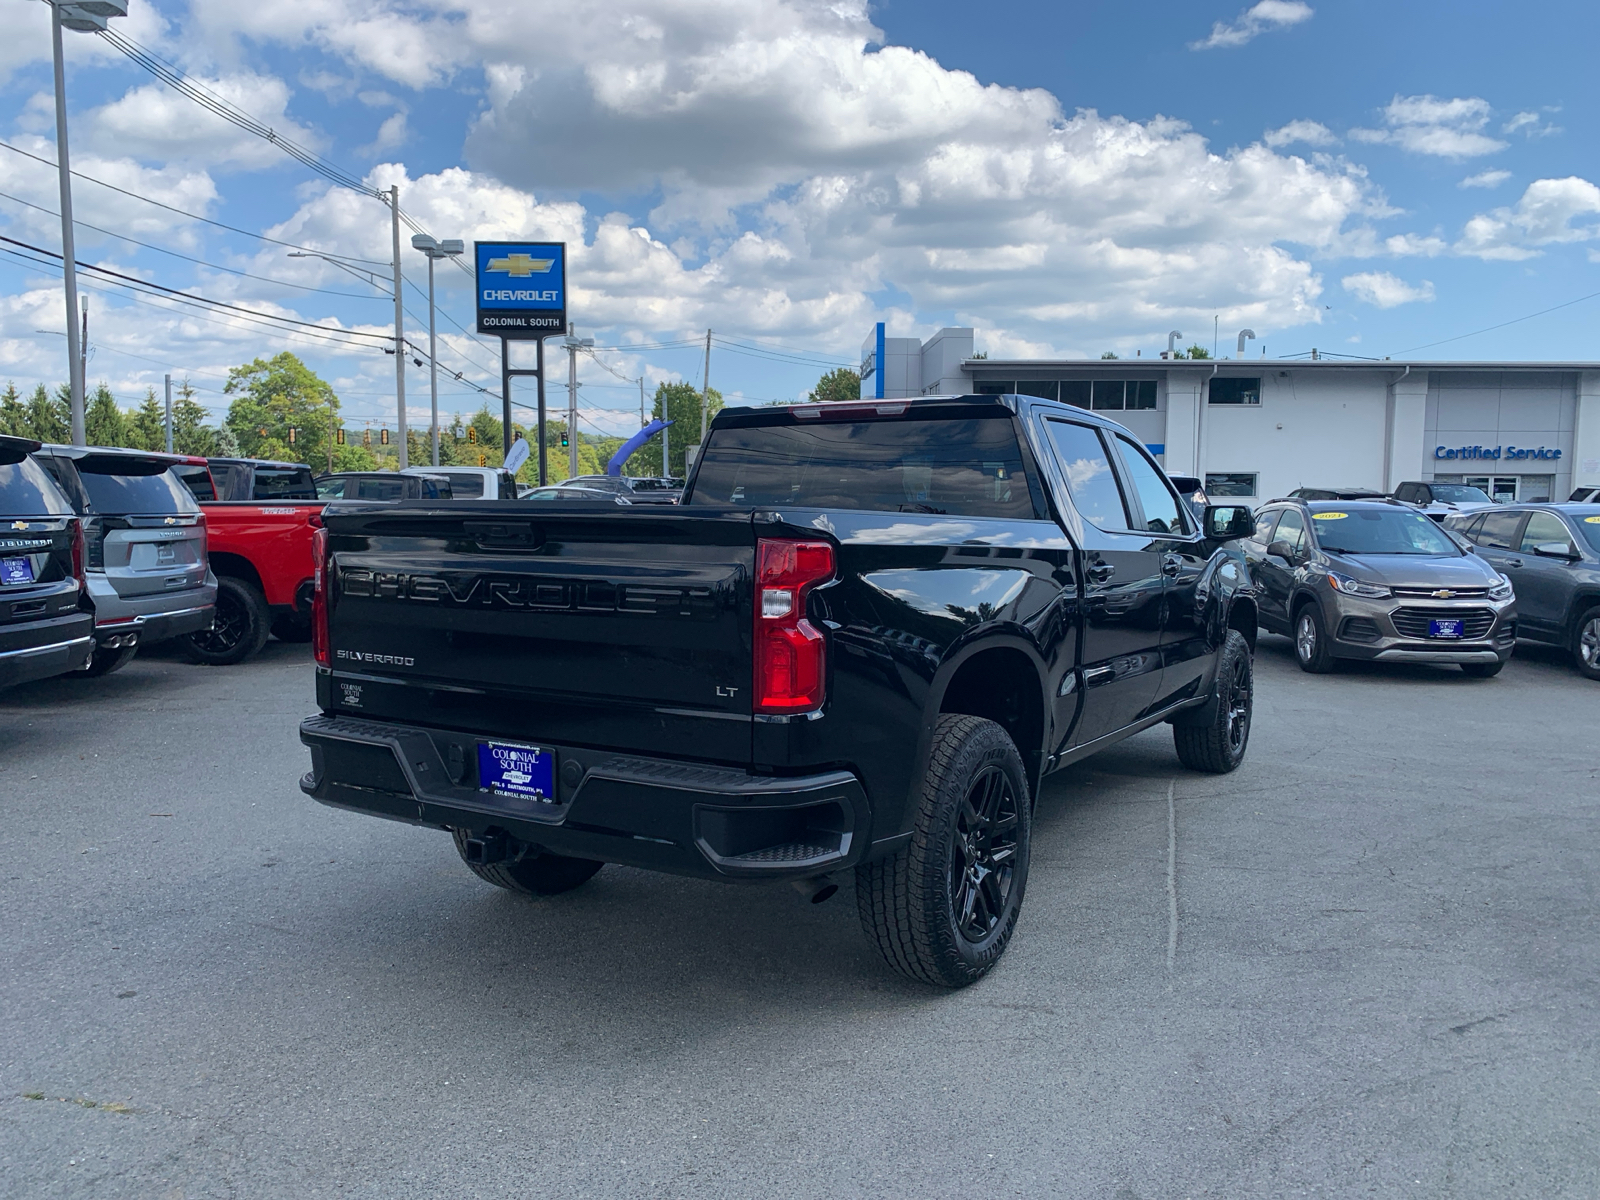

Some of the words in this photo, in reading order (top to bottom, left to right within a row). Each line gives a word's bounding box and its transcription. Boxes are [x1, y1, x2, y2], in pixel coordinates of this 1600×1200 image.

[483, 290, 559, 301] CHEVROLET
[483, 317, 528, 326] COLONIAL
[529, 318, 560, 327] SOUTH
[1435, 445, 1502, 460] Certified
[1506, 446, 1562, 460] Service
[0, 539, 53, 547] UBURBAN
[343, 570, 712, 616] CHEVROLET
[337, 649, 415, 666] SILVERADO
[340, 683, 364, 692] COLONIAL
[344, 689, 360, 697] SOUTH
[716, 685, 739, 698] LT
[492, 748, 540, 764] COLONIAL
[500, 759, 532, 772] SOUTH
[504, 773, 530, 781] CHEVROLET
[494, 789, 520, 798] COLONIAL
[520, 793, 538, 801] SOUTH
